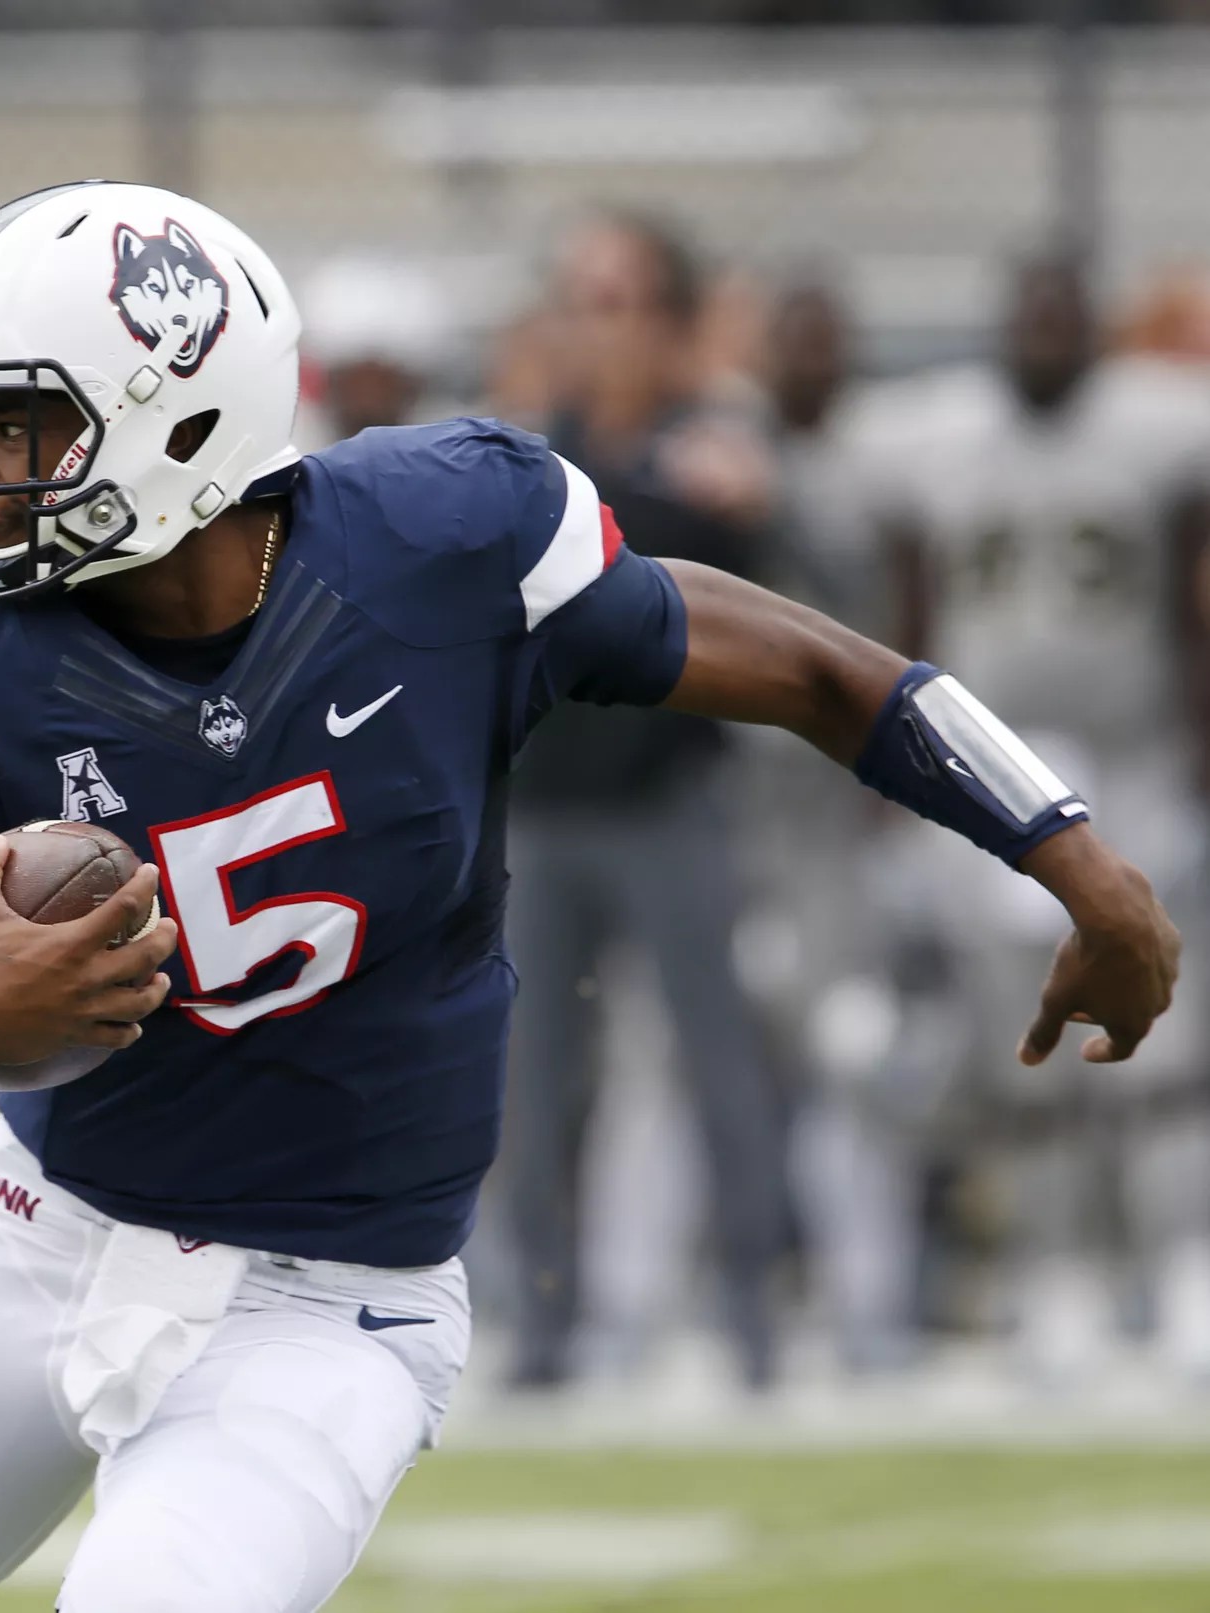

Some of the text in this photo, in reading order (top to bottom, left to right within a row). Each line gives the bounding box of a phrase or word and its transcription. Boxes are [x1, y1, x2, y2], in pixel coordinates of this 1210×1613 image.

[46, 442, 89, 506] dell
[55, 746, 128, 823] A
[147, 769, 367, 1037] 5
